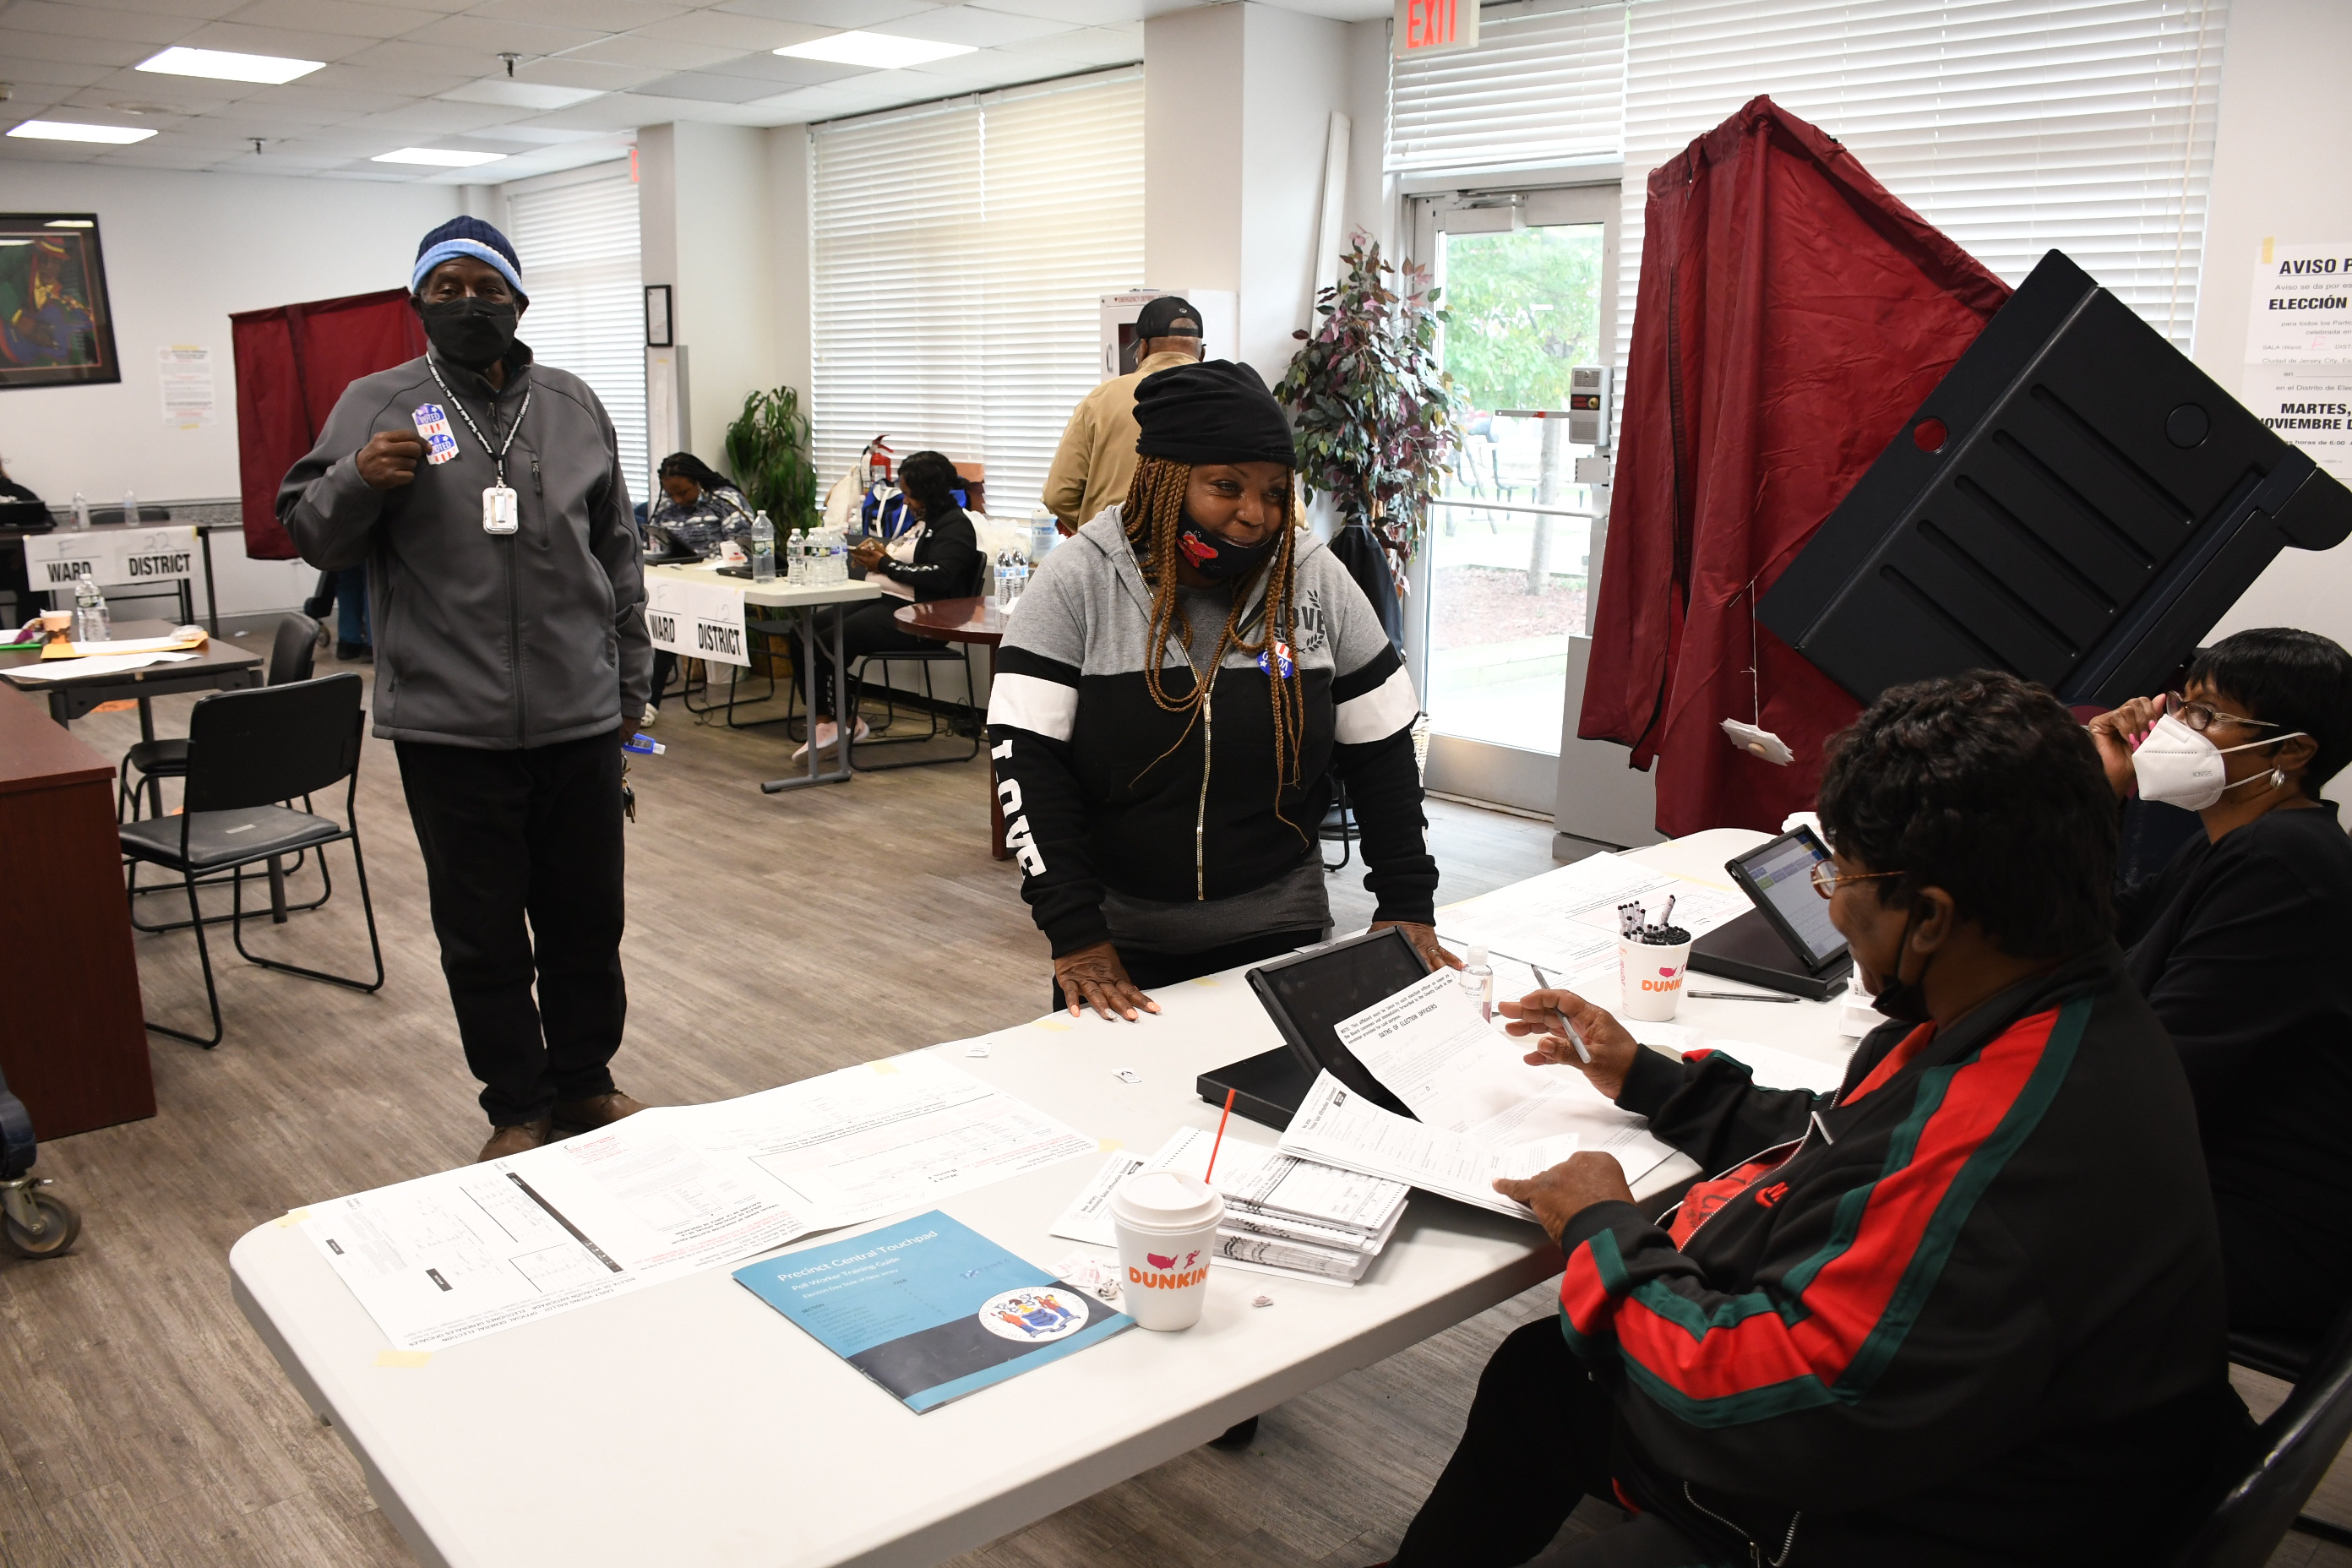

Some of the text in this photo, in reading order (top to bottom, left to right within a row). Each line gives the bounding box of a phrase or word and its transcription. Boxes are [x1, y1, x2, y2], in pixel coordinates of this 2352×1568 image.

[2279, 259, 2336, 274] AVISO
[2269, 295, 2347, 309] ELECCIÓN
[419, 413, 440, 424] VOTED
[2261, 418, 2341, 429] OVIEMBRE
[2281, 403, 2351, 416] MARTES,
[47, 553, 190, 582] WARD DISTRICT
[649, 614, 741, 656] WARD DISTRICT
[1359, 1015, 1372, 1025] affidavit
[1408, 990, 1420, 999] election
[1360, 1022, 1375, 1031] convenes
[1381, 1009, 1400, 1020] immediately
[1400, 1000, 1414, 1009] forwarded
[1379, 1028, 1392, 1037] OATHS
[1400, 1015, 1418, 1026] ELECTION
[1418, 1004, 1437, 1016] OFFICERS
[778, 1231, 937, 1281] Precinct Central Touchpad
[809, 1274, 841, 1285] Worker
[875, 1258, 900, 1266] Guide
